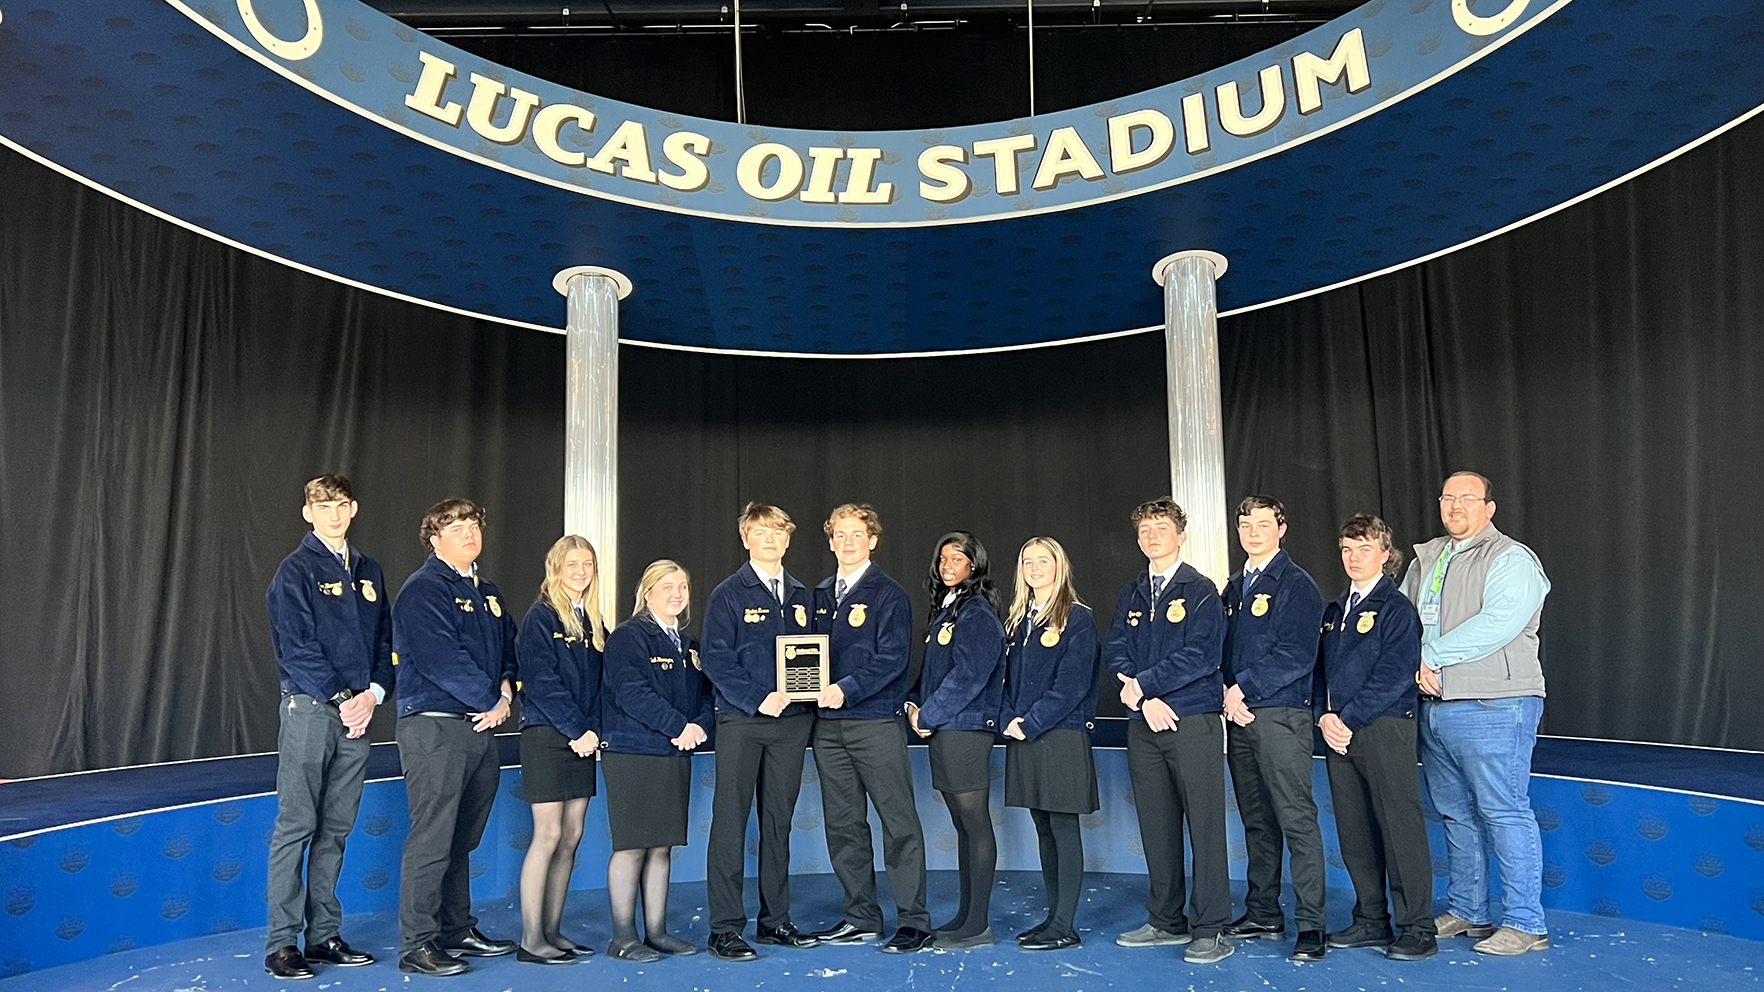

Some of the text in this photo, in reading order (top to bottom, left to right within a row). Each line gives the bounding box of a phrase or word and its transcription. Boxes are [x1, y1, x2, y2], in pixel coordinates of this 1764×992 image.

[404, 27, 1371, 204] LUCAS OIL STADIUM
